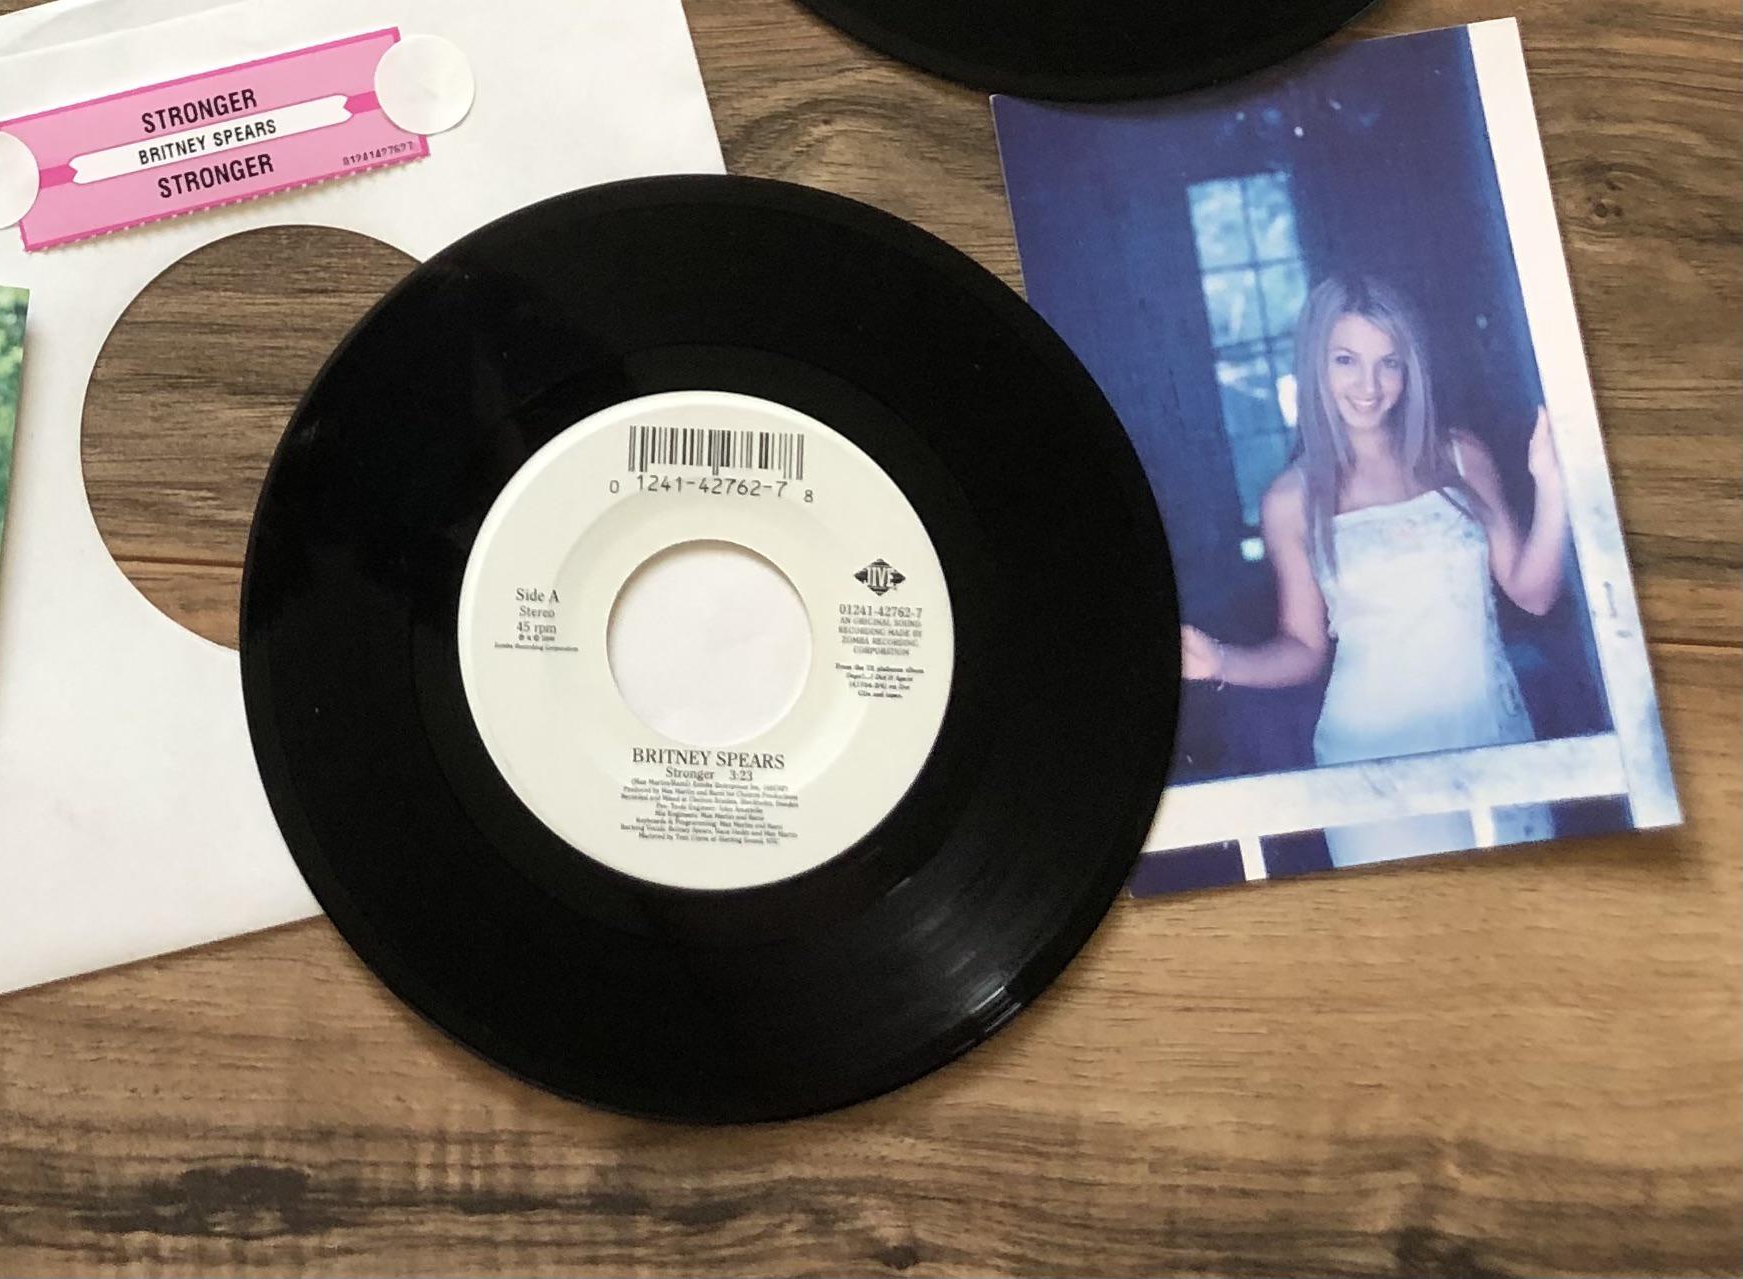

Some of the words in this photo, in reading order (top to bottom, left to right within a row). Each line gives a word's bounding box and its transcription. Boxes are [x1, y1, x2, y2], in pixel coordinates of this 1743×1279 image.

[141, 88, 258, 134] STRONGER
[138, 135, 206, 166] BRITNEY
[213, 119, 277, 147] SPEARS
[157, 153, 275, 199] STRONGER
[609, 479, 620, 494] 0
[636, 474, 789, 498] 1241-42762-7
[803, 489, 814, 504] 8
[862, 566, 895, 589] JIVE
[515, 586, 546, 602] Side
[548, 588, 560, 604] A
[518, 604, 556, 619] Stereo
[838, 603, 923, 619] 01241-42762-7
[516, 620, 531, 633] 45
[533, 623, 557, 635] rpm
[632, 746, 711, 767] BRITNEY
[714, 750, 786, 770] SPEARS
[664, 765, 715, 782] Stronger
[728, 768, 754, 782] 3:23
